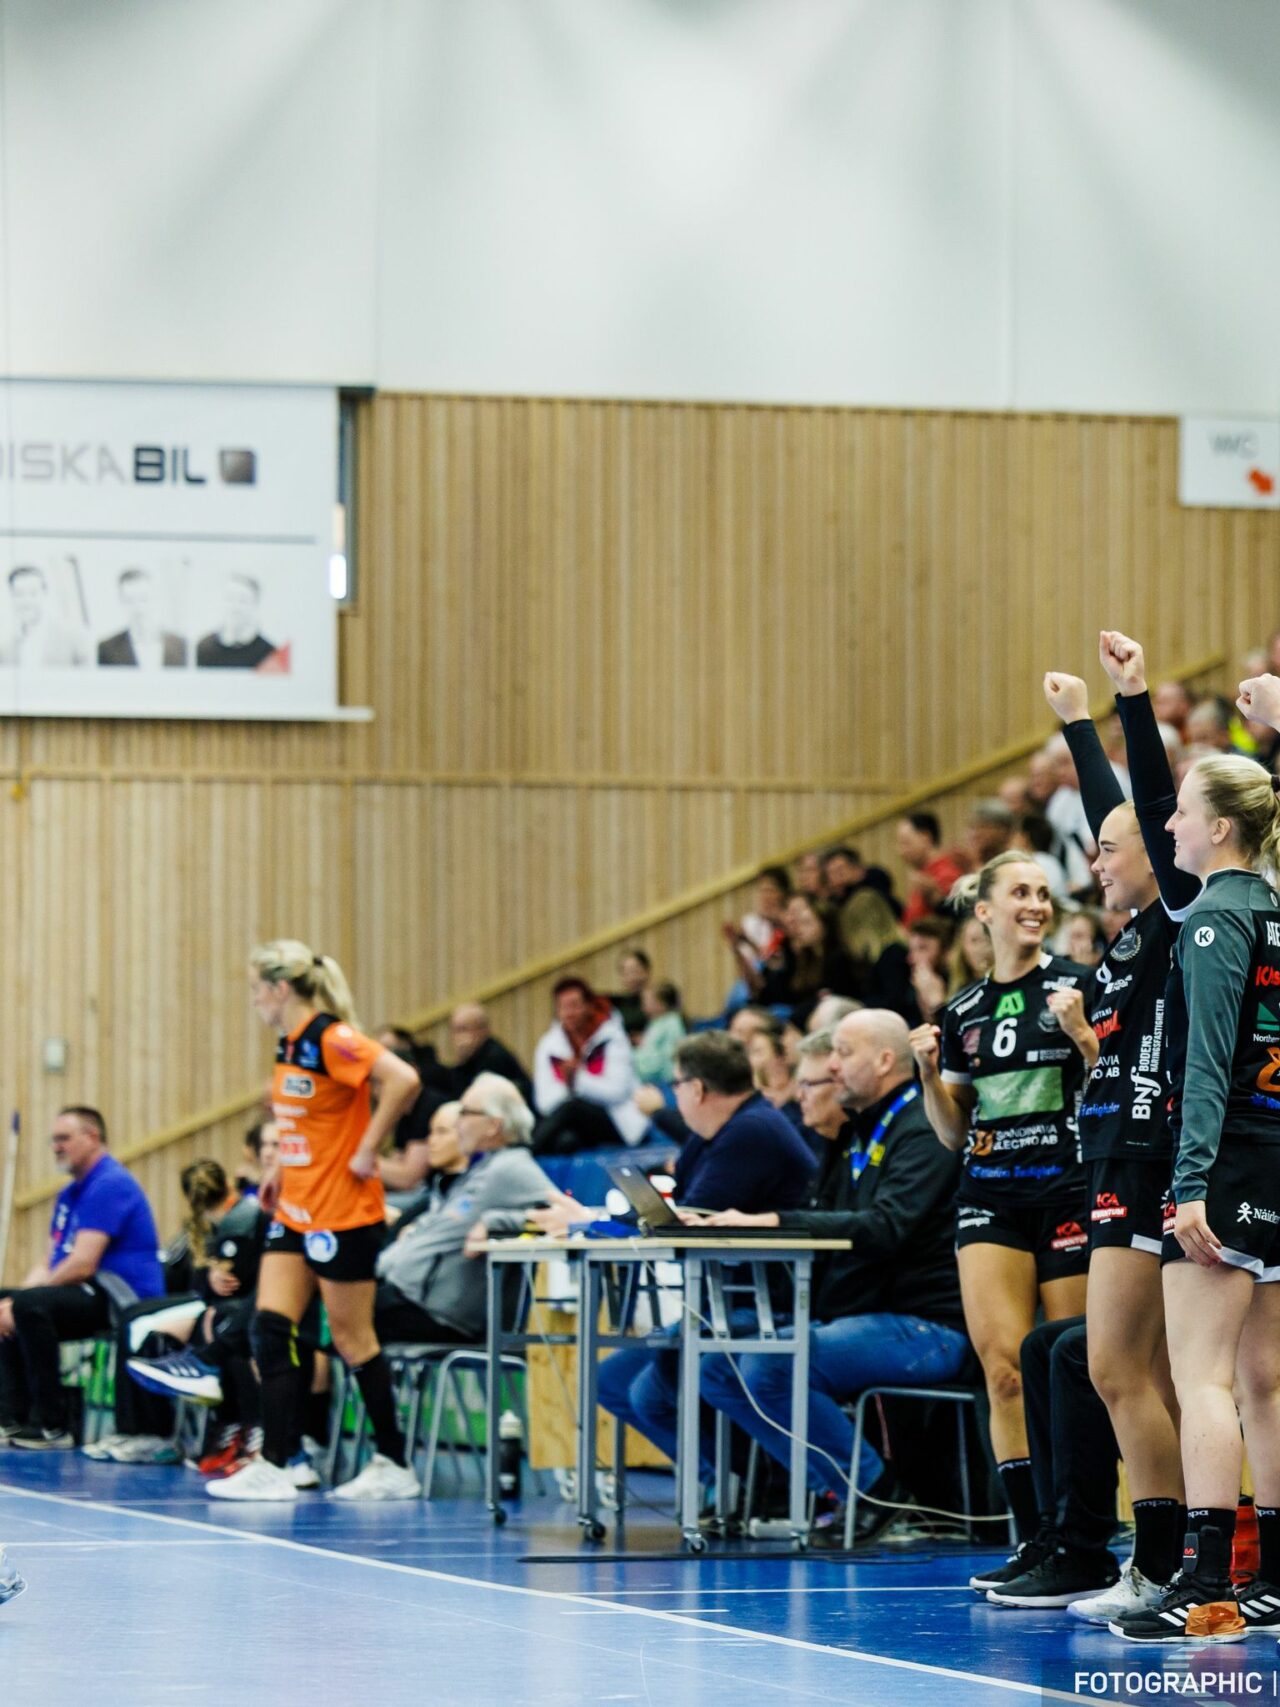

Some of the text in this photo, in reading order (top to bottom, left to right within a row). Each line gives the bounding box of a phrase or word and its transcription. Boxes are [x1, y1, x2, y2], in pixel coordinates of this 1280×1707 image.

[992, 1017, 1018, 1058] 6
[1138, 1035, 1153, 1072] BODENS
[1105, 1066, 1120, 1078] AB
[1040, 1134, 1059, 1146] AB
[1096, 1192, 1120, 1207] ICA
